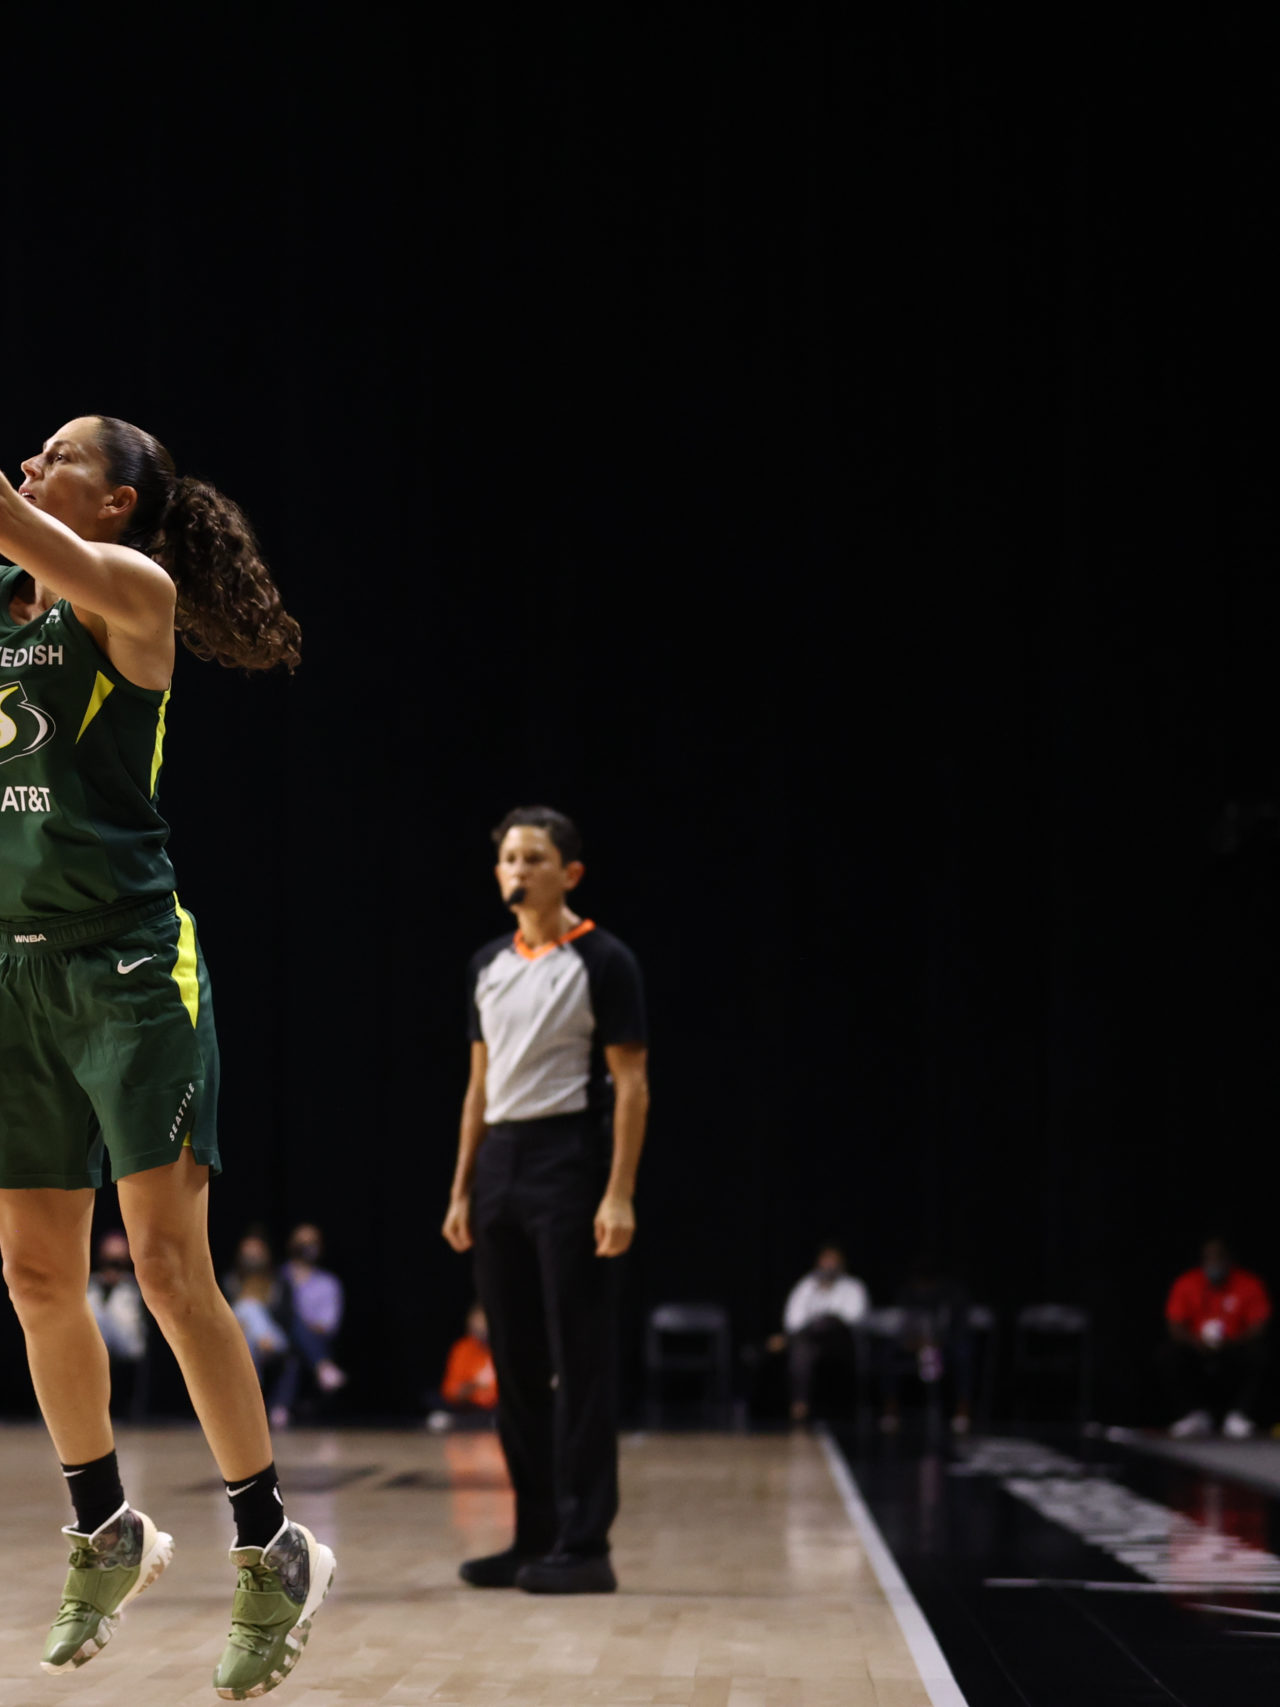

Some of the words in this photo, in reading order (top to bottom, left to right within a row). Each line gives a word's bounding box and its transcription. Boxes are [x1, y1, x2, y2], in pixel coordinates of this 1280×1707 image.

[0, 785, 52, 813] AT&T
[14, 932, 47, 943] WNBA
[169, 1082, 195, 1142] SEATTLE
